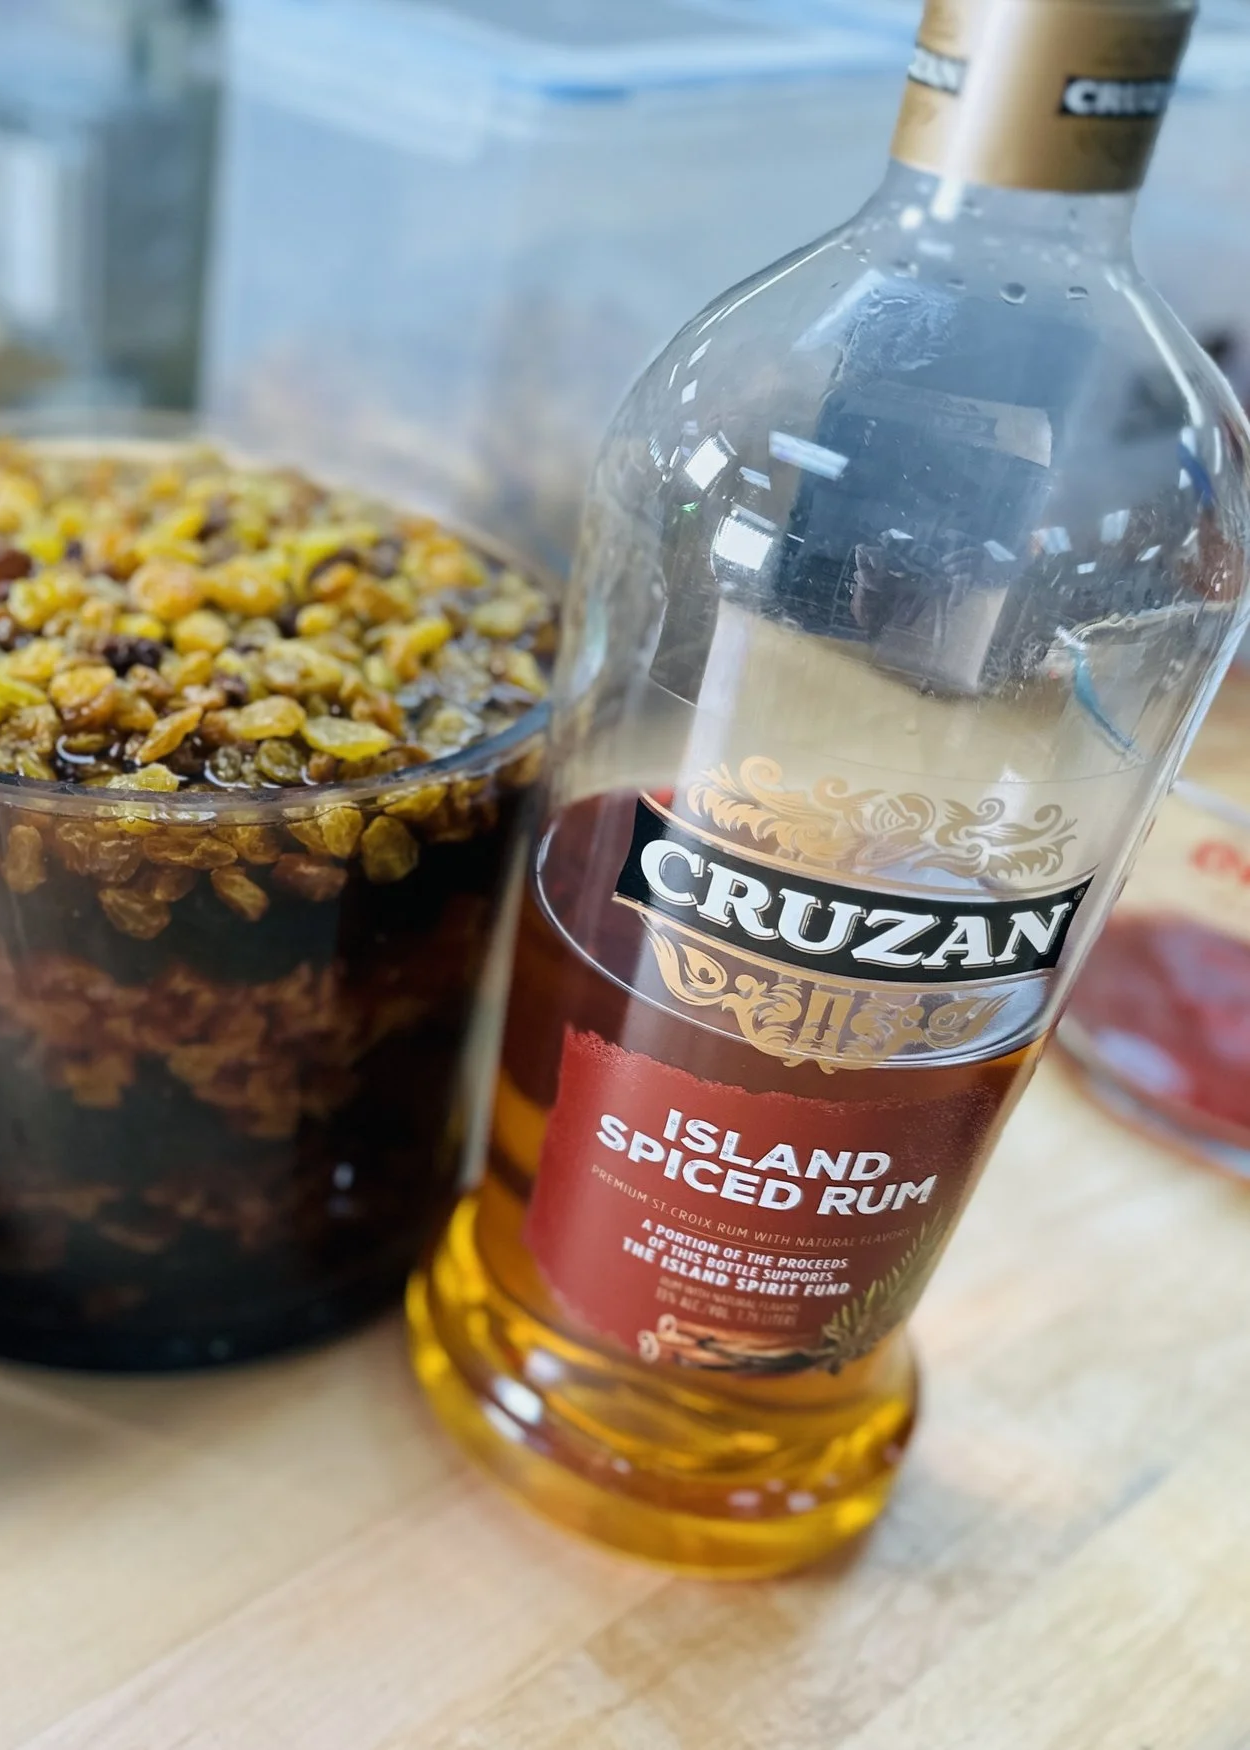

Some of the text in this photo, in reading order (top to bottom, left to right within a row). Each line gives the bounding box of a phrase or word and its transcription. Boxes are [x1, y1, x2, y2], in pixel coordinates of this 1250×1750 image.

[639, 838, 1073, 970] CRUZAN
[595, 1113, 939, 1217] SPICED RUM
[661, 1107, 892, 1182] ISLAND
[590, 1164, 648, 1203] PREMIUM
[716, 1221, 749, 1238] RUM
[753, 1232, 792, 1246] WITH
[795, 1236, 855, 1249] NATURAL
[859, 1227, 911, 1246] FLAVORS
[622, 1235, 851, 1298] THE ISLAND SPIRIT FUND
[640, 1218, 849, 1271] A PORTION OF THE PROCEEDS
[647, 1235, 835, 1284] OF THIS BOTTLE SUPPORTS
